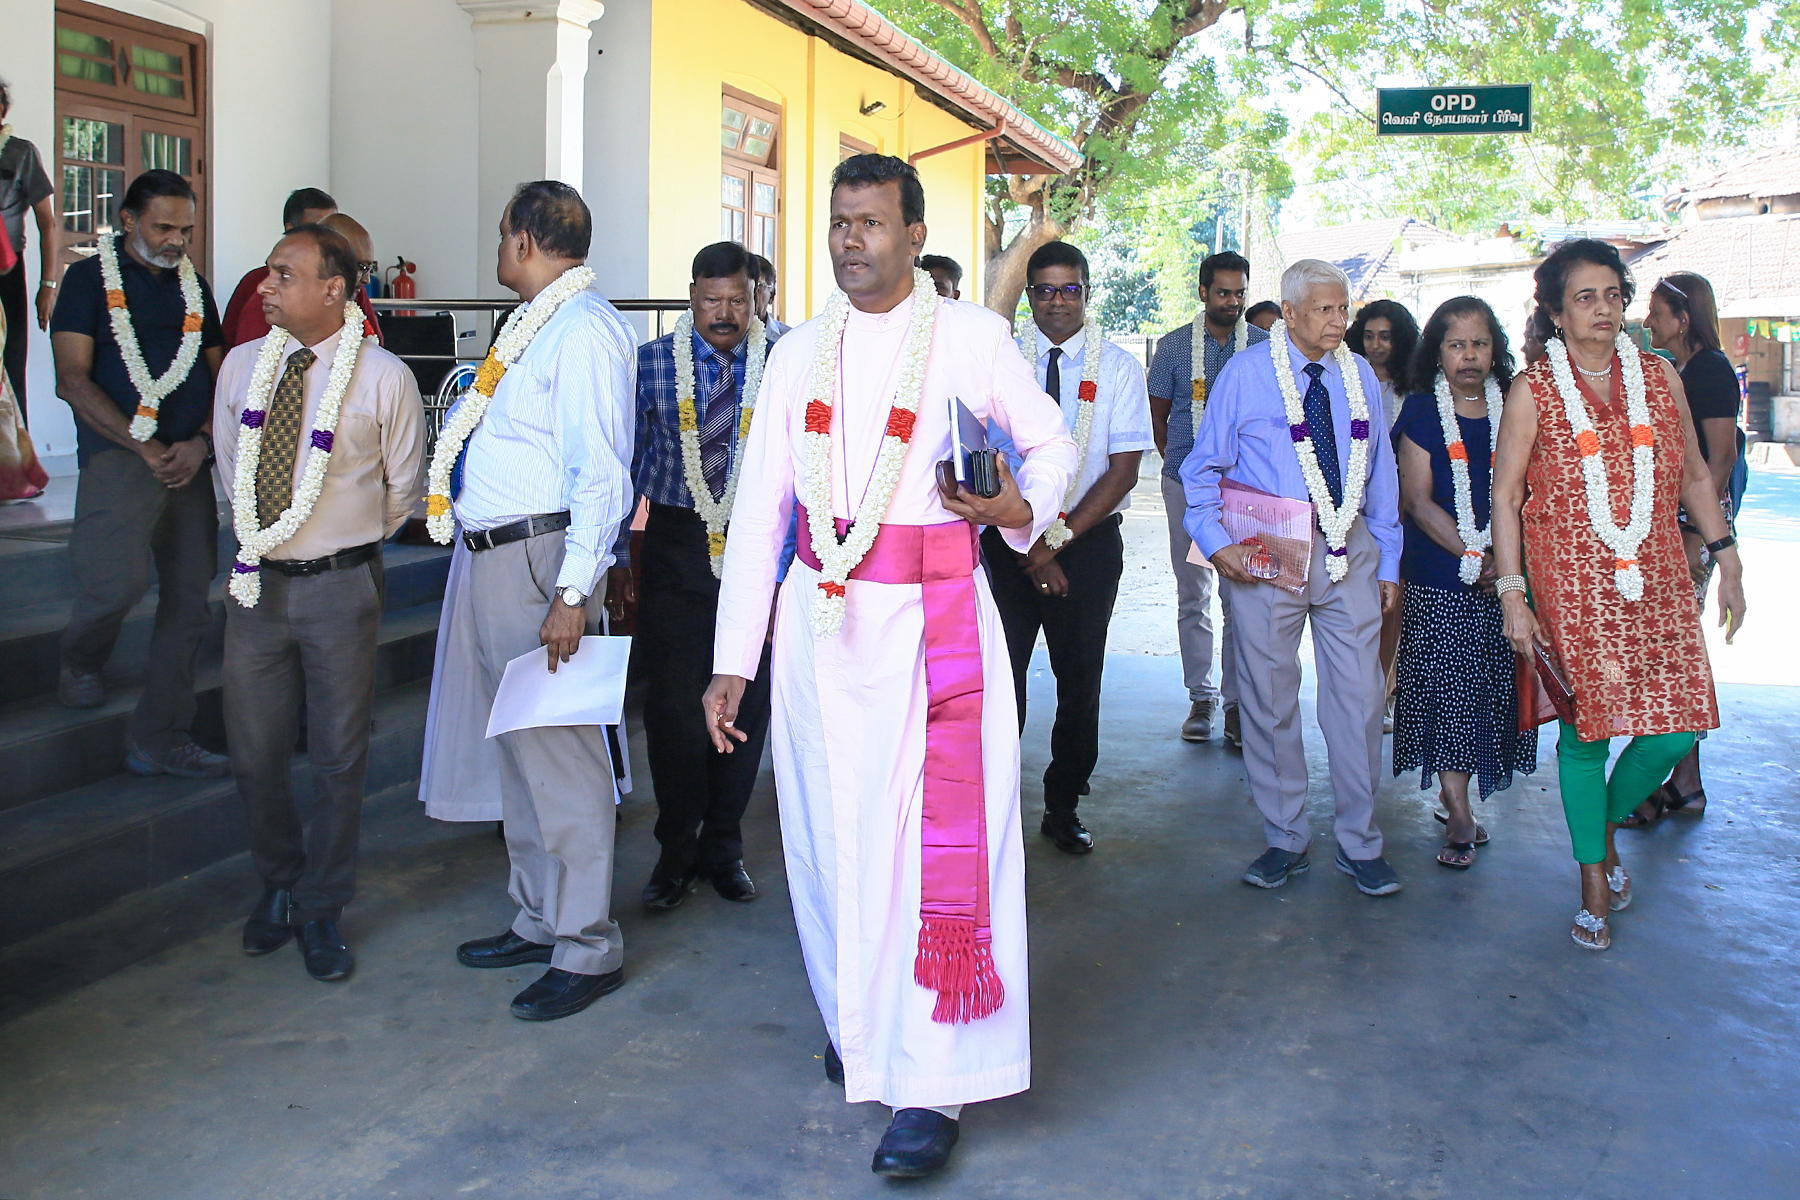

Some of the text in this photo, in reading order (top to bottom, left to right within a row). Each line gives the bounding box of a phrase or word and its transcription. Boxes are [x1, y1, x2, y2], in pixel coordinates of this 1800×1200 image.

[1431, 94, 1476, 111] OPD
[1382, 108, 1524, 127] வெளி நோயாளர் பிரிவு
